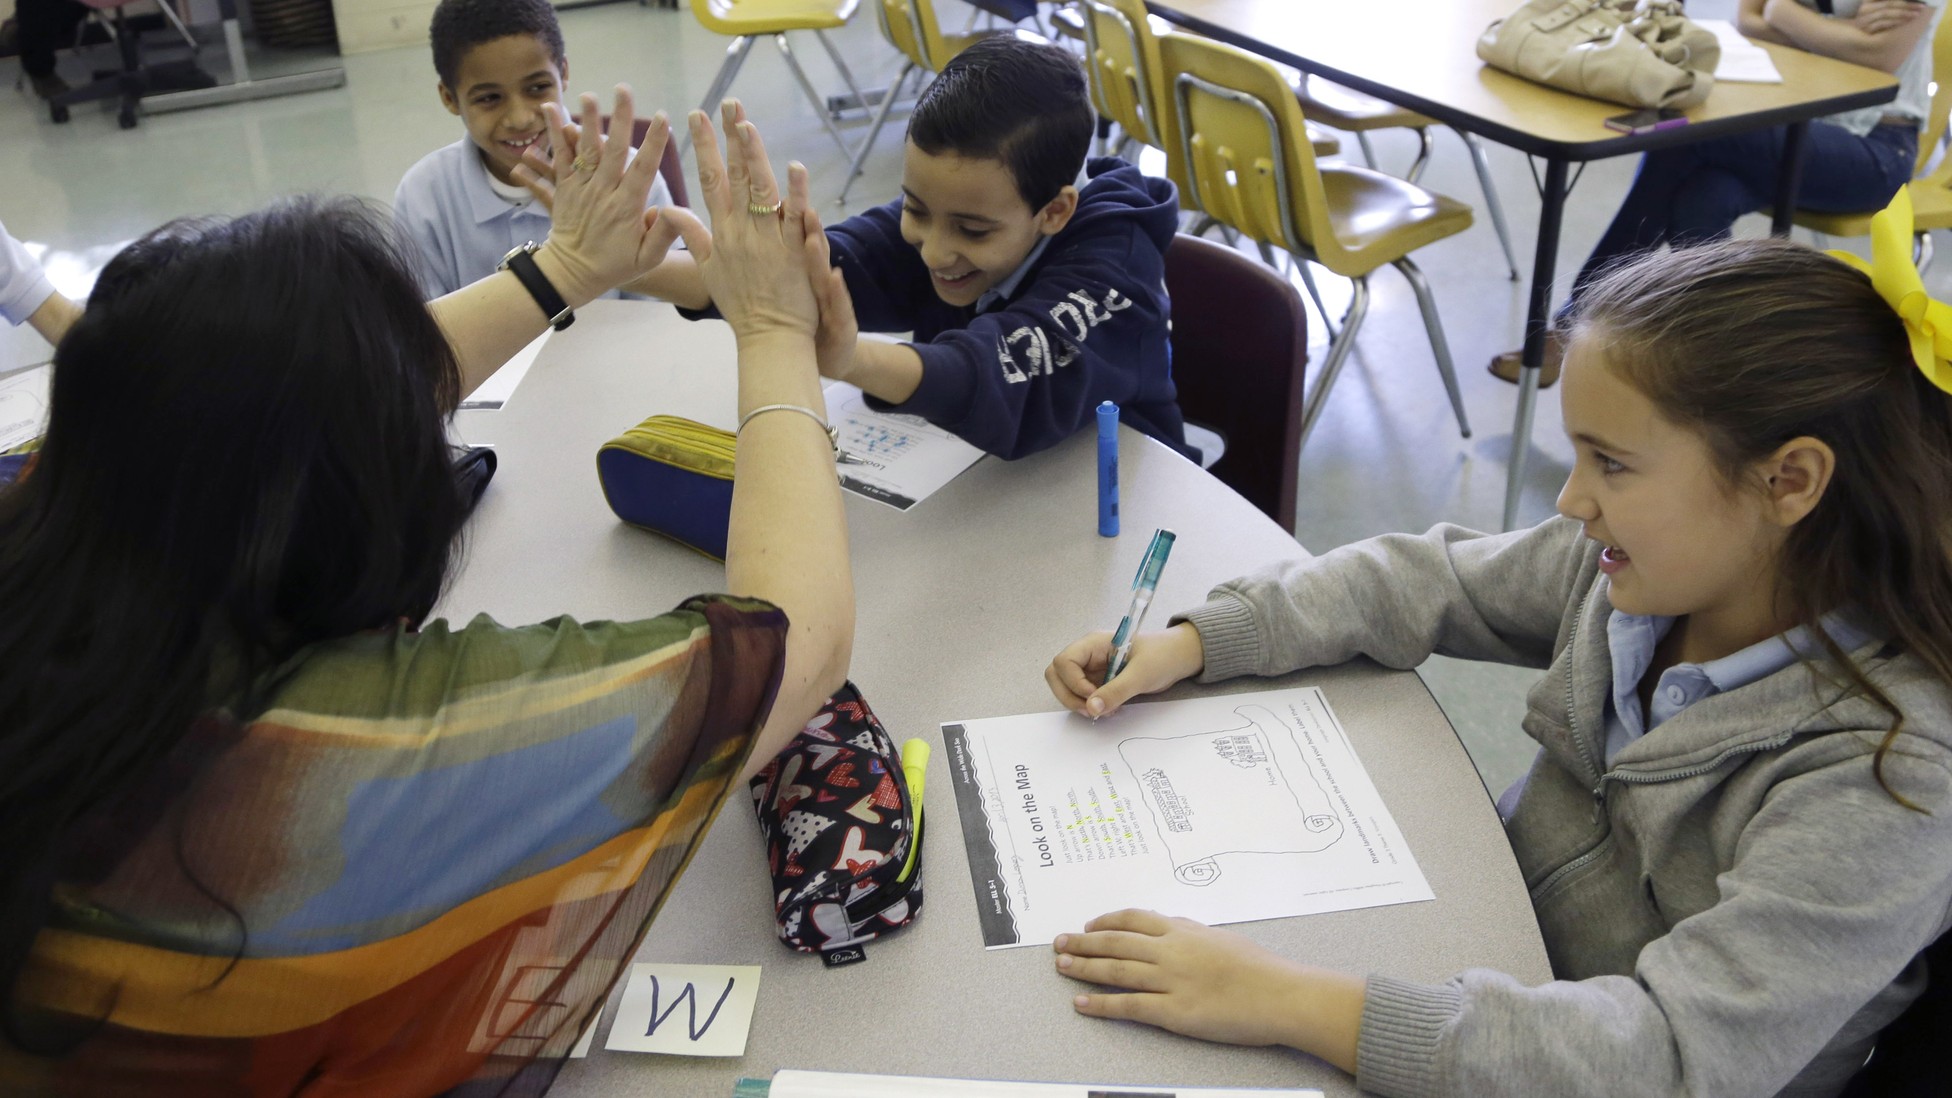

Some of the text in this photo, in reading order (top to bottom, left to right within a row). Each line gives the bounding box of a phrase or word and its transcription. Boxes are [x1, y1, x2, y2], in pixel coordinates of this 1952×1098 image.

[1293, 716, 1306, 730] Label
[1310, 745, 1322, 757] your
[1315, 757, 1327, 767] and
[1265, 766, 1278, 786] Home
[1321, 767, 1336, 785] school
[1332, 785, 1341, 794] the
[1337, 794, 1355, 817] between
[1014, 764, 1054, 868] Look on the Map
[1128, 811, 1137, 821] the
[1054, 819, 1063, 829] the
[1351, 817, 1370, 847] landmarks
[1059, 838, 1069, 852] look
[1064, 852, 1073, 864] Just
[1367, 847, 1380, 864] Draw
[989, 888, 999, 899] ELL
[644, 974, 735, 1041] W
